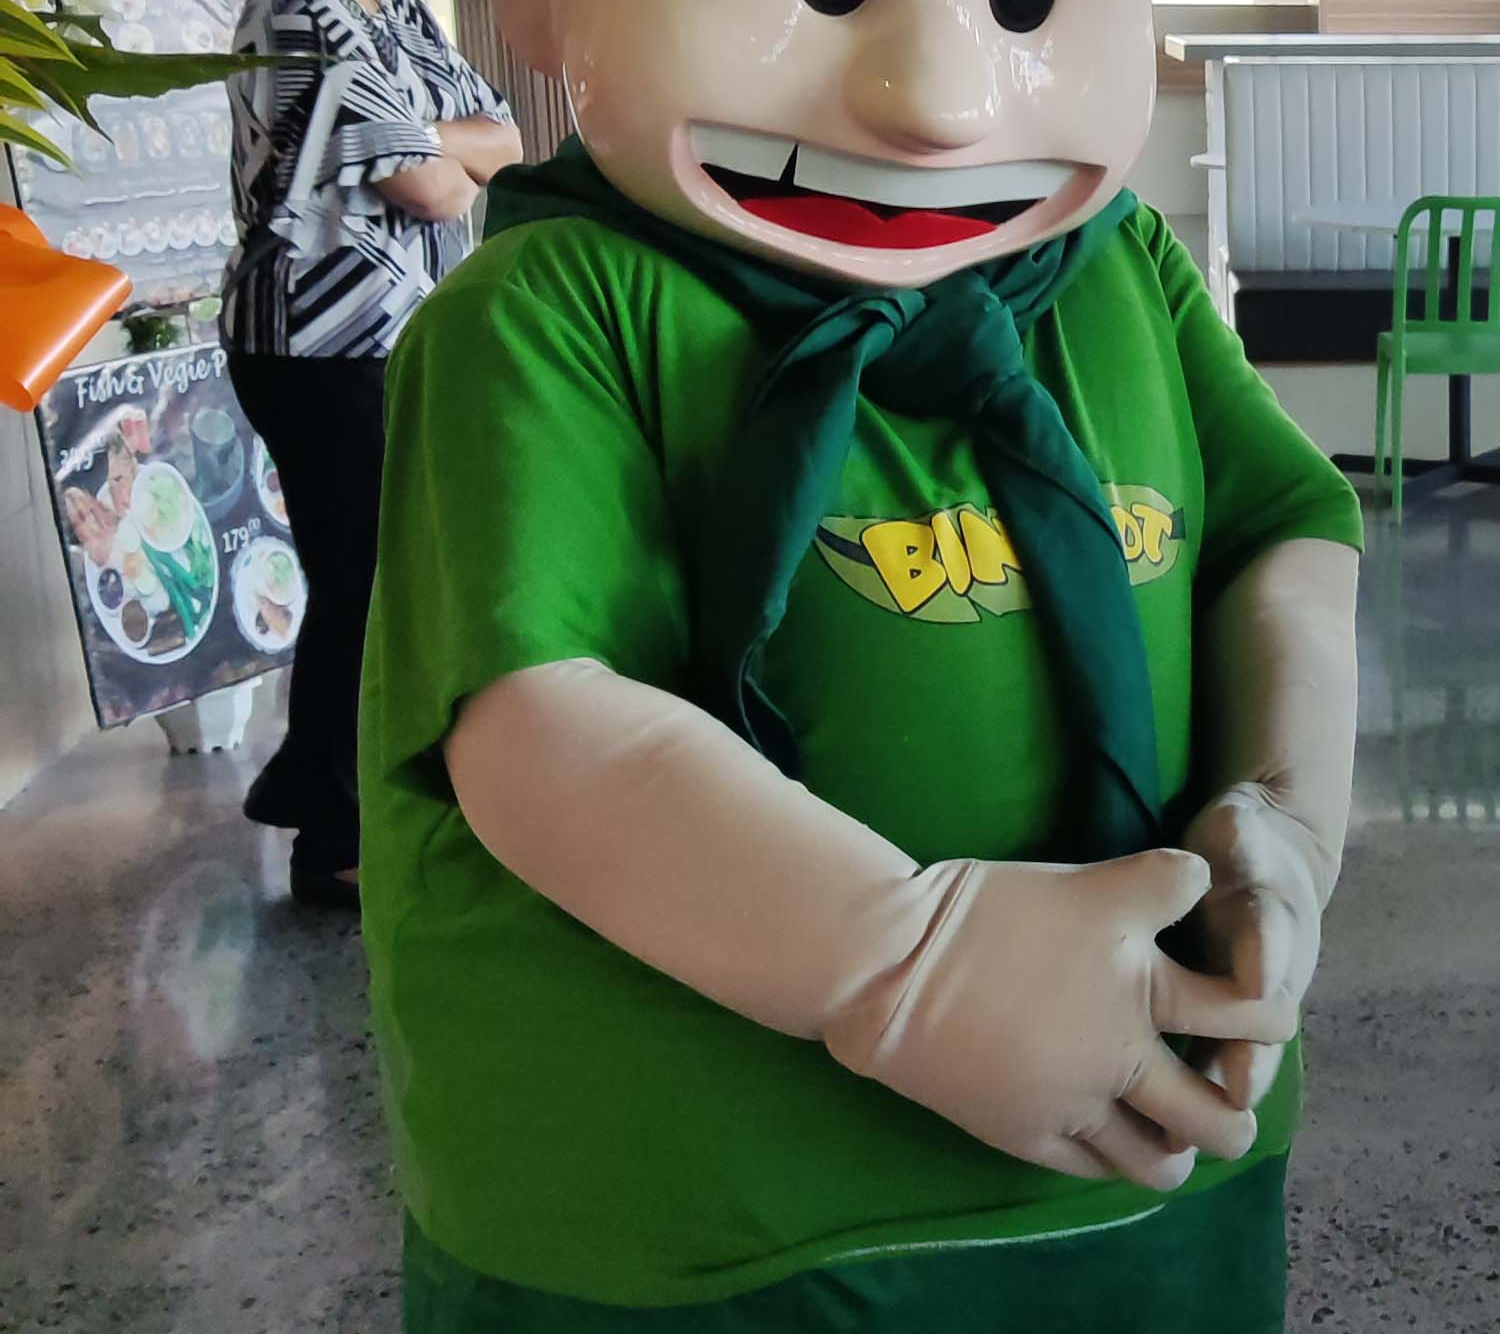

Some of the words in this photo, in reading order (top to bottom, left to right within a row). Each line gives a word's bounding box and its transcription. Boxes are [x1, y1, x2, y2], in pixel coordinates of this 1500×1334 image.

[75, 366, 124, 409] Fish
[127, 364, 144, 395] &
[148, 354, 210, 394] Vegie
